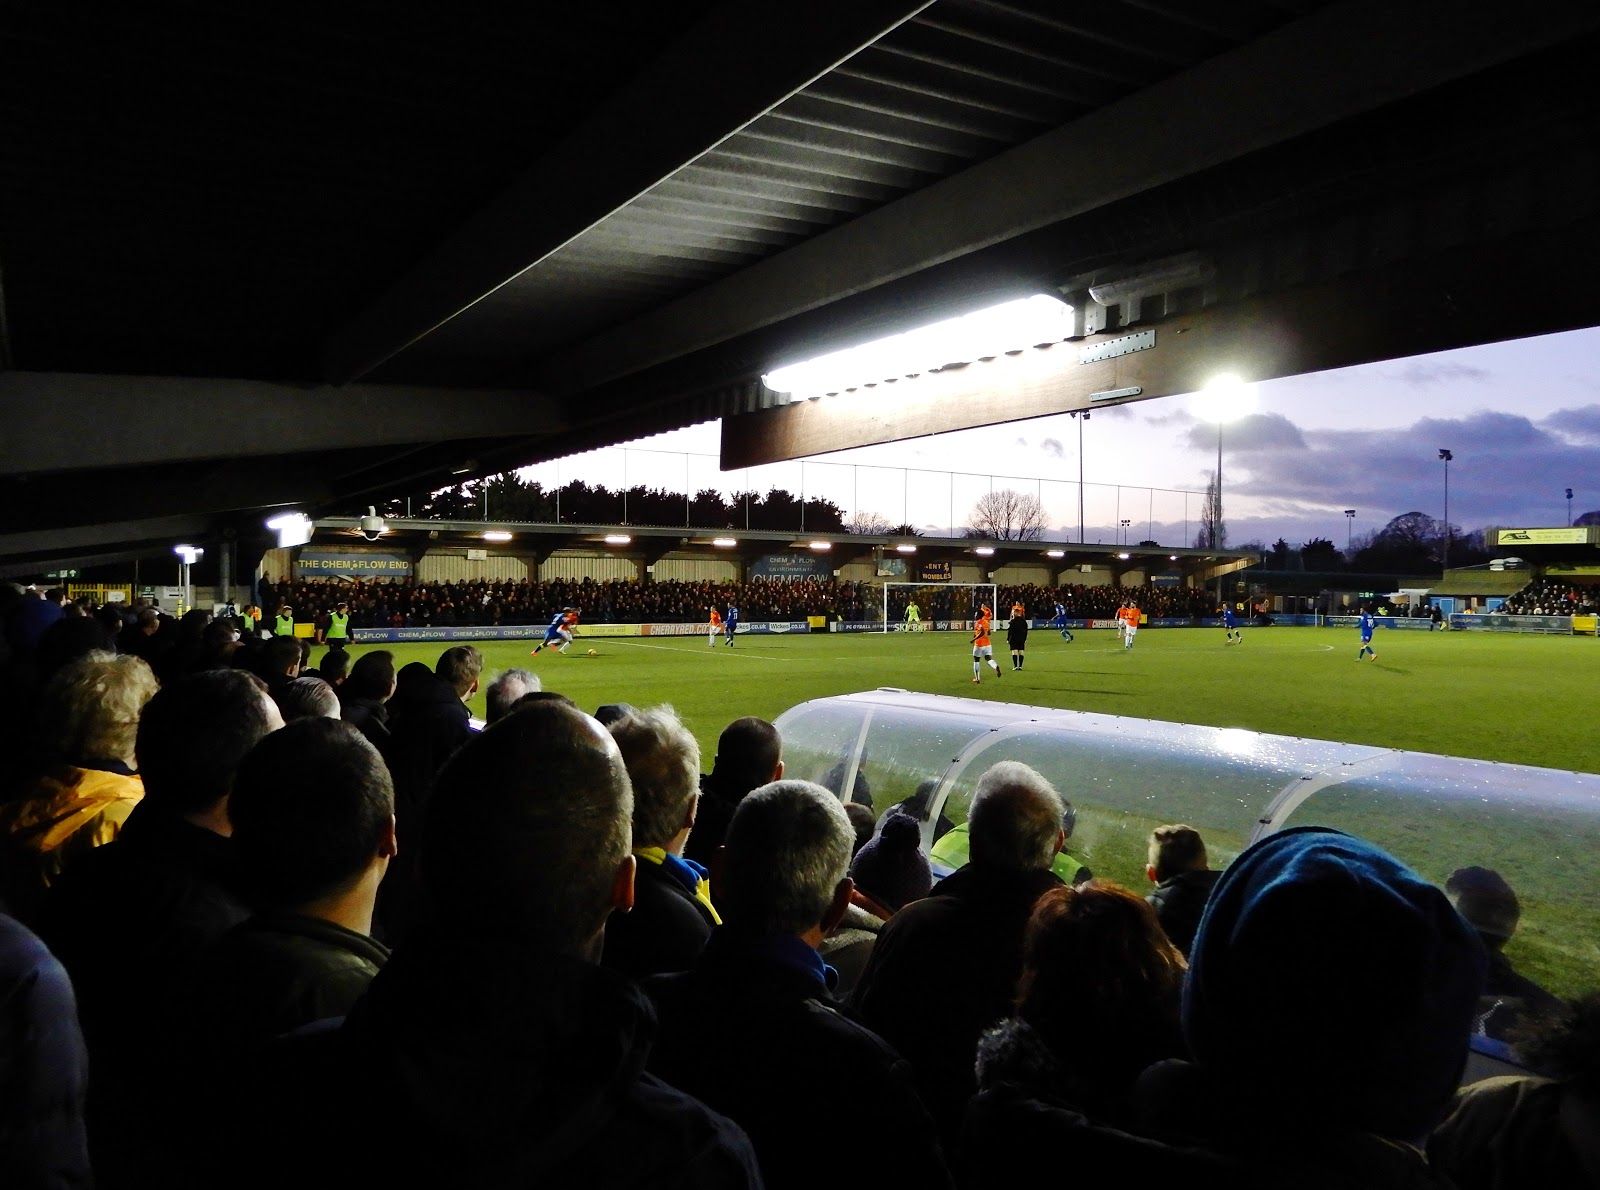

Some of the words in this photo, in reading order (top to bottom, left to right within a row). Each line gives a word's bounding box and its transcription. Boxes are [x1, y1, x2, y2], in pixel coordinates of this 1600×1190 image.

[299, 560, 319, 568] THE
[389, 561, 409, 569] END
[951, 622, 963, 630] BET
